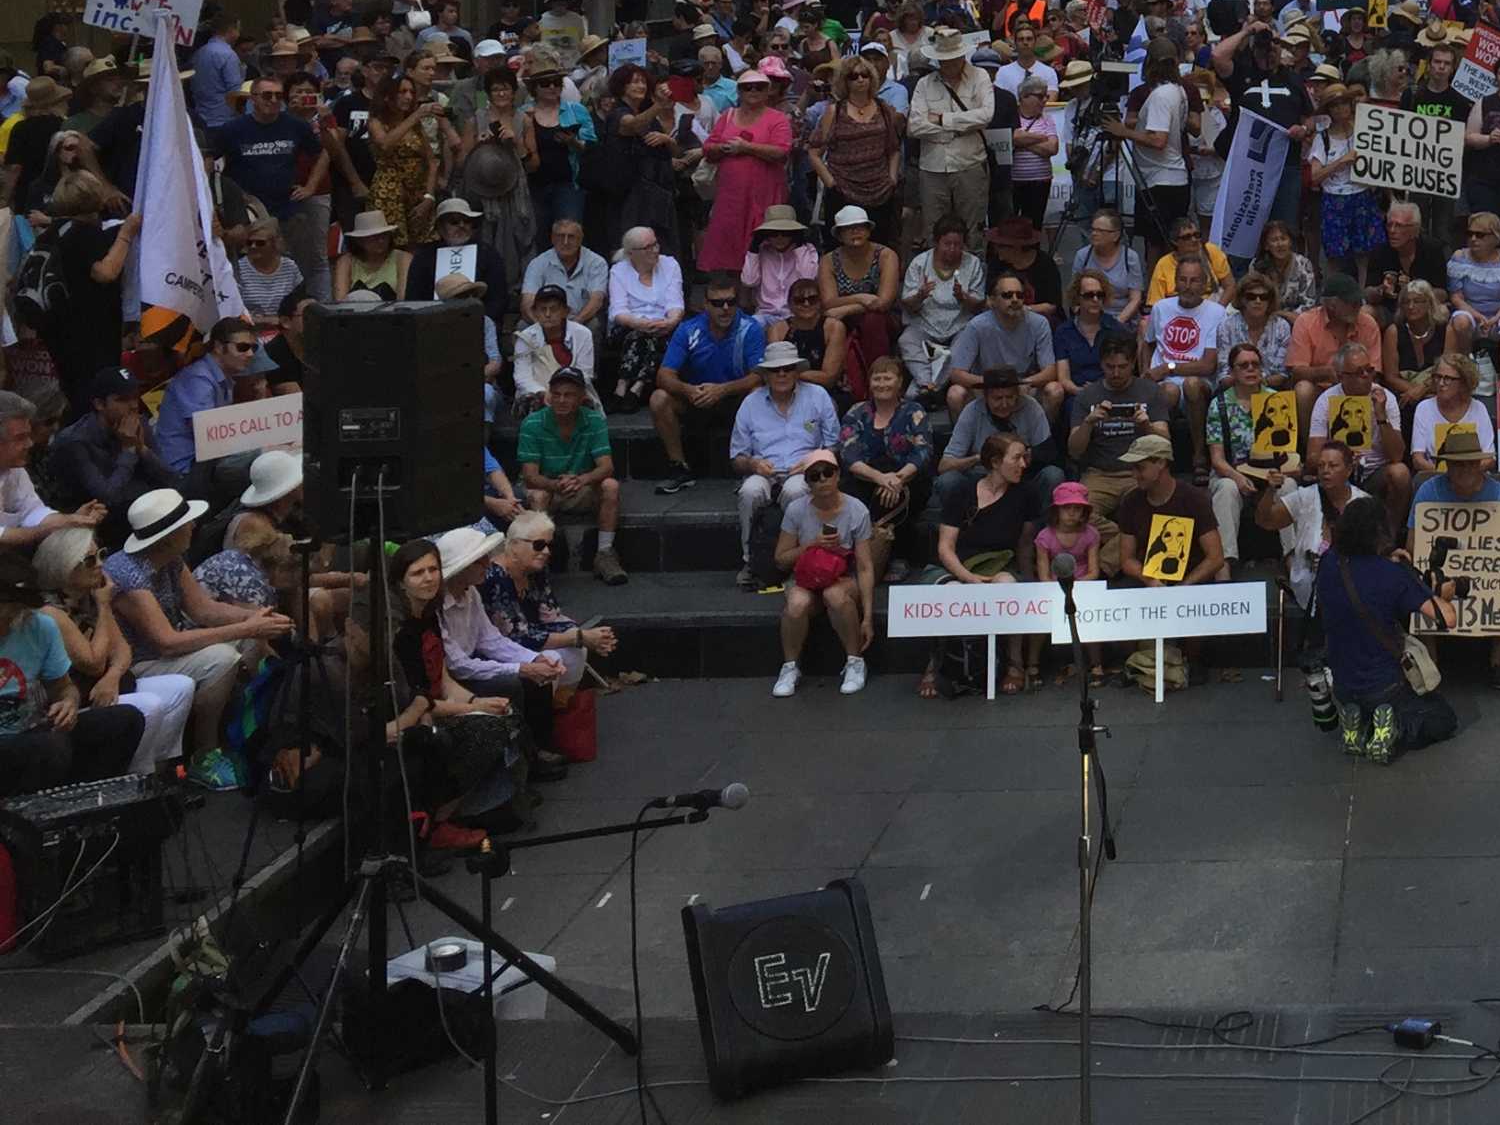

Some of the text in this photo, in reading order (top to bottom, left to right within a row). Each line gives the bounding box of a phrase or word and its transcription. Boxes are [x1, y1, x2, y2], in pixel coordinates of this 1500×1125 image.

[92, 3, 141, 33] inc.
[1463, 63, 1479, 76] THE
[1468, 77, 1491, 93] WEST
[1416, 104, 1453, 117] NOFX
[1367, 108, 1452, 144] STOP
[1356, 132, 1454, 169] SELLING
[1353, 155, 1396, 183] OUR
[1402, 164, 1458, 196] BUSES
[1166, 325, 1197, 345] STOP
[206, 411, 294, 442] KIDS CALL TO
[1421, 507, 1491, 533] STOP
[904, 602, 944, 619] KIDS
[948, 600, 991, 618] CALL
[995, 600, 1021, 617] TO
[1139, 601, 1251, 620] THE CHILDREN
